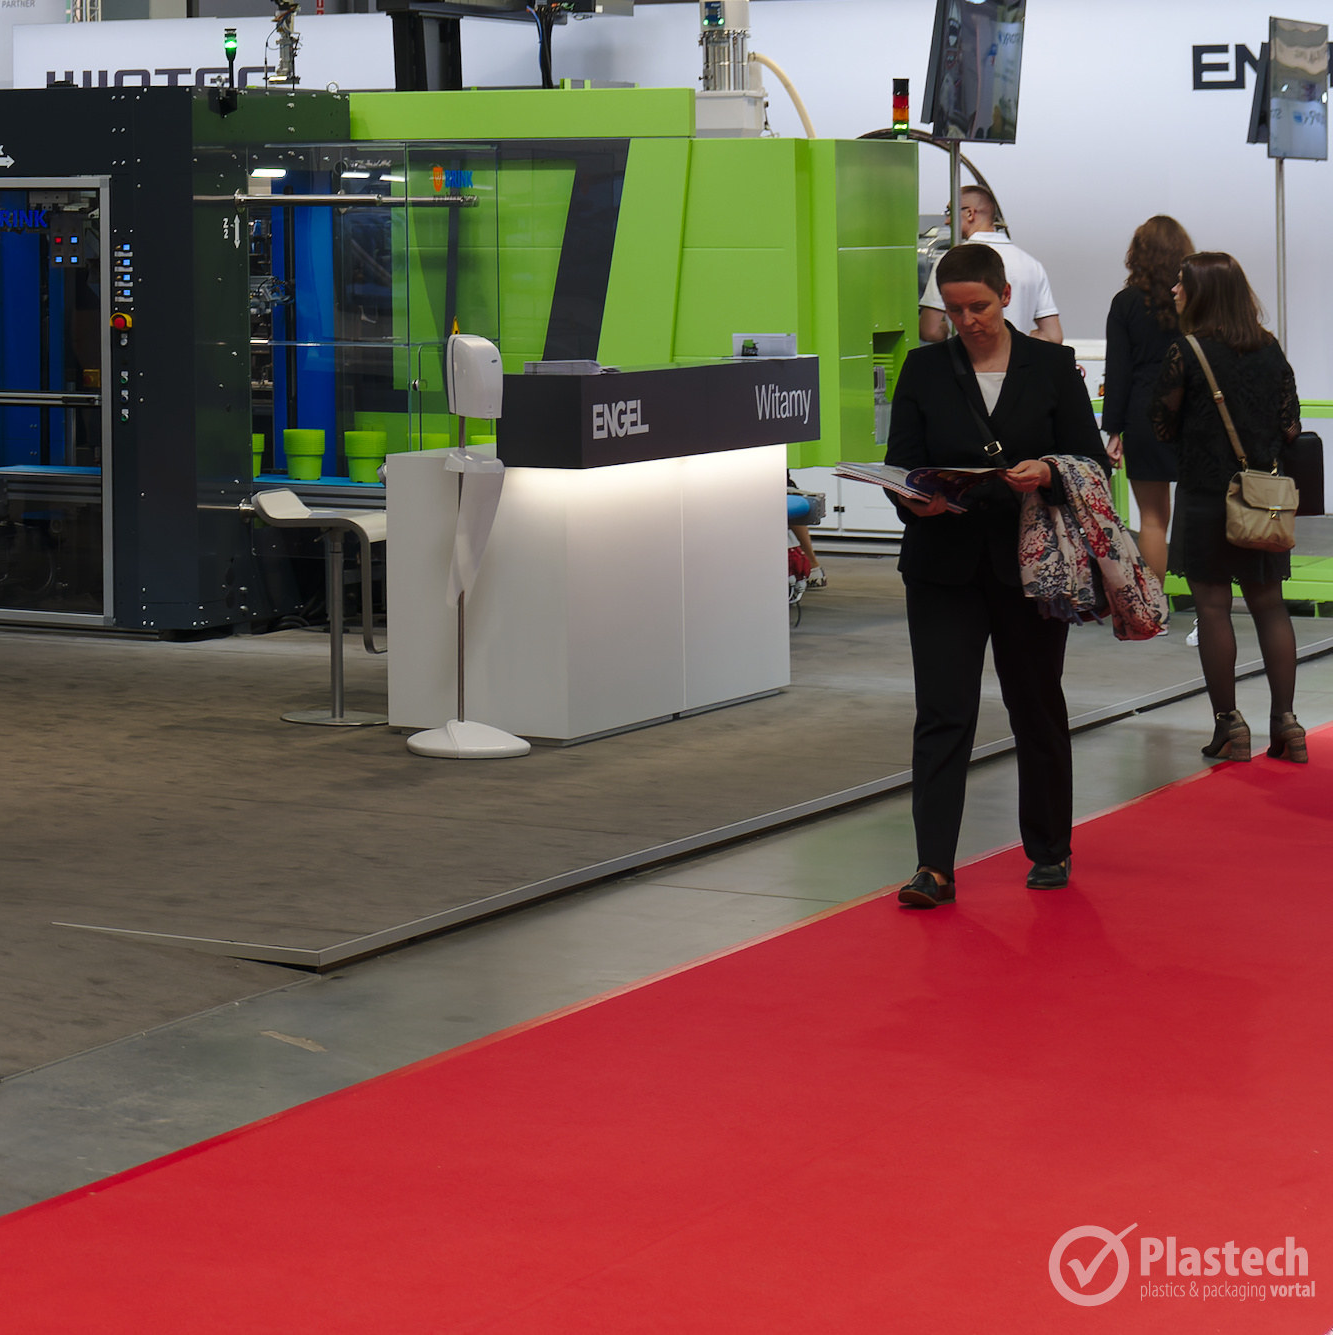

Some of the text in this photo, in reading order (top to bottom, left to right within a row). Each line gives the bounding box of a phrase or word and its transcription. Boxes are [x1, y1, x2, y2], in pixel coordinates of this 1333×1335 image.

[1, 0, 36, 9] PARTNER
[592, 399, 649, 440] ENGEL
[754, 383, 812, 425] Witamy
